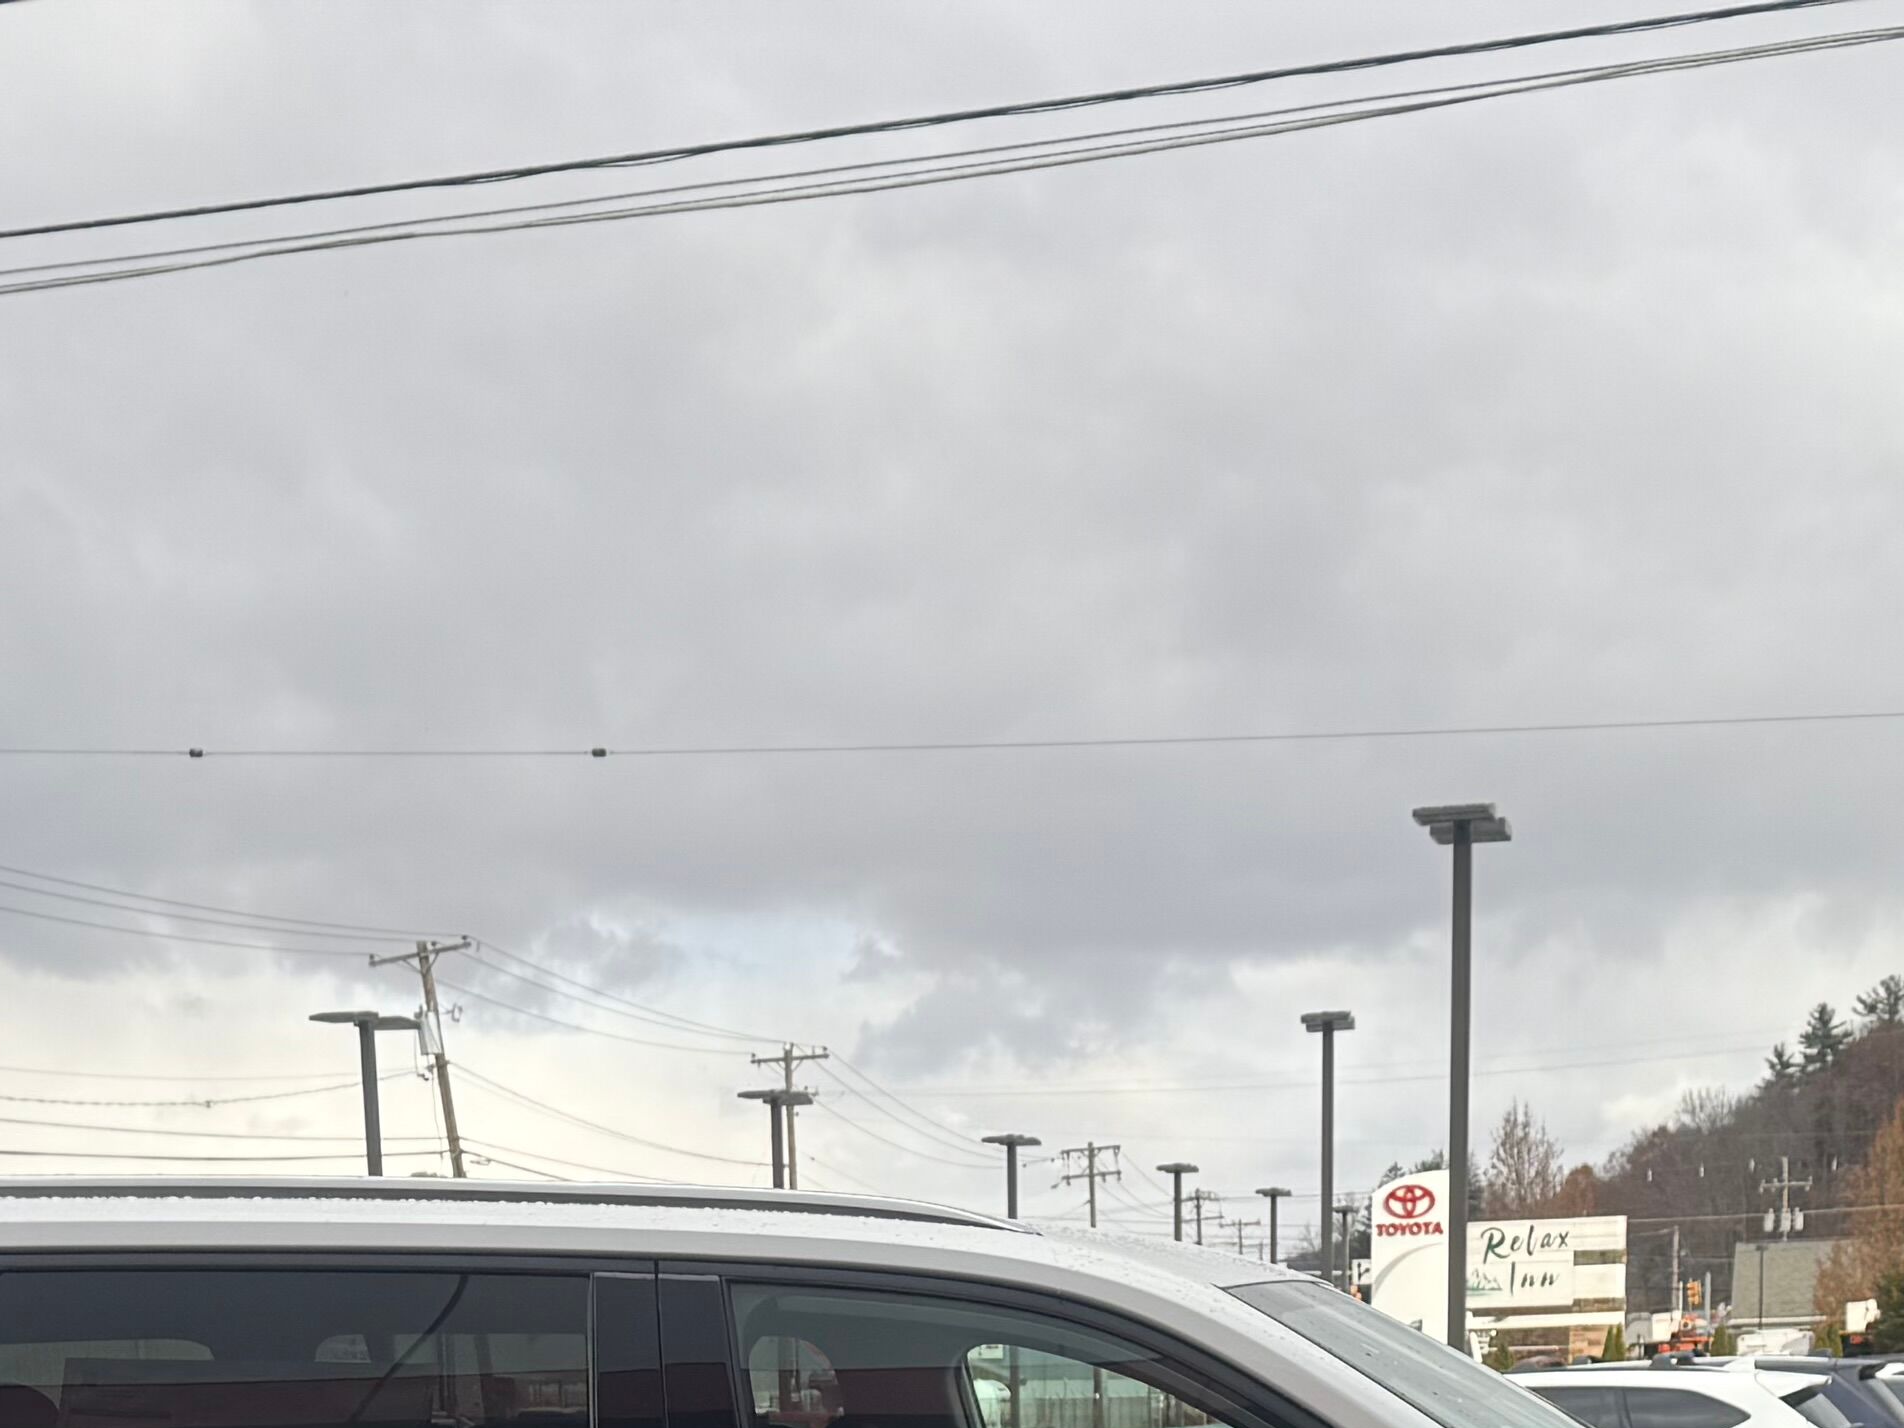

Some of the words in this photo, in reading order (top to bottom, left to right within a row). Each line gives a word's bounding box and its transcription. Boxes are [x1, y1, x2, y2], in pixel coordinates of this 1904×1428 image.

[1375, 1221, 1444, 1237] TOYOTA
[1480, 1224, 1570, 1264] Relax
[1510, 1261, 1559, 1296] Inn
